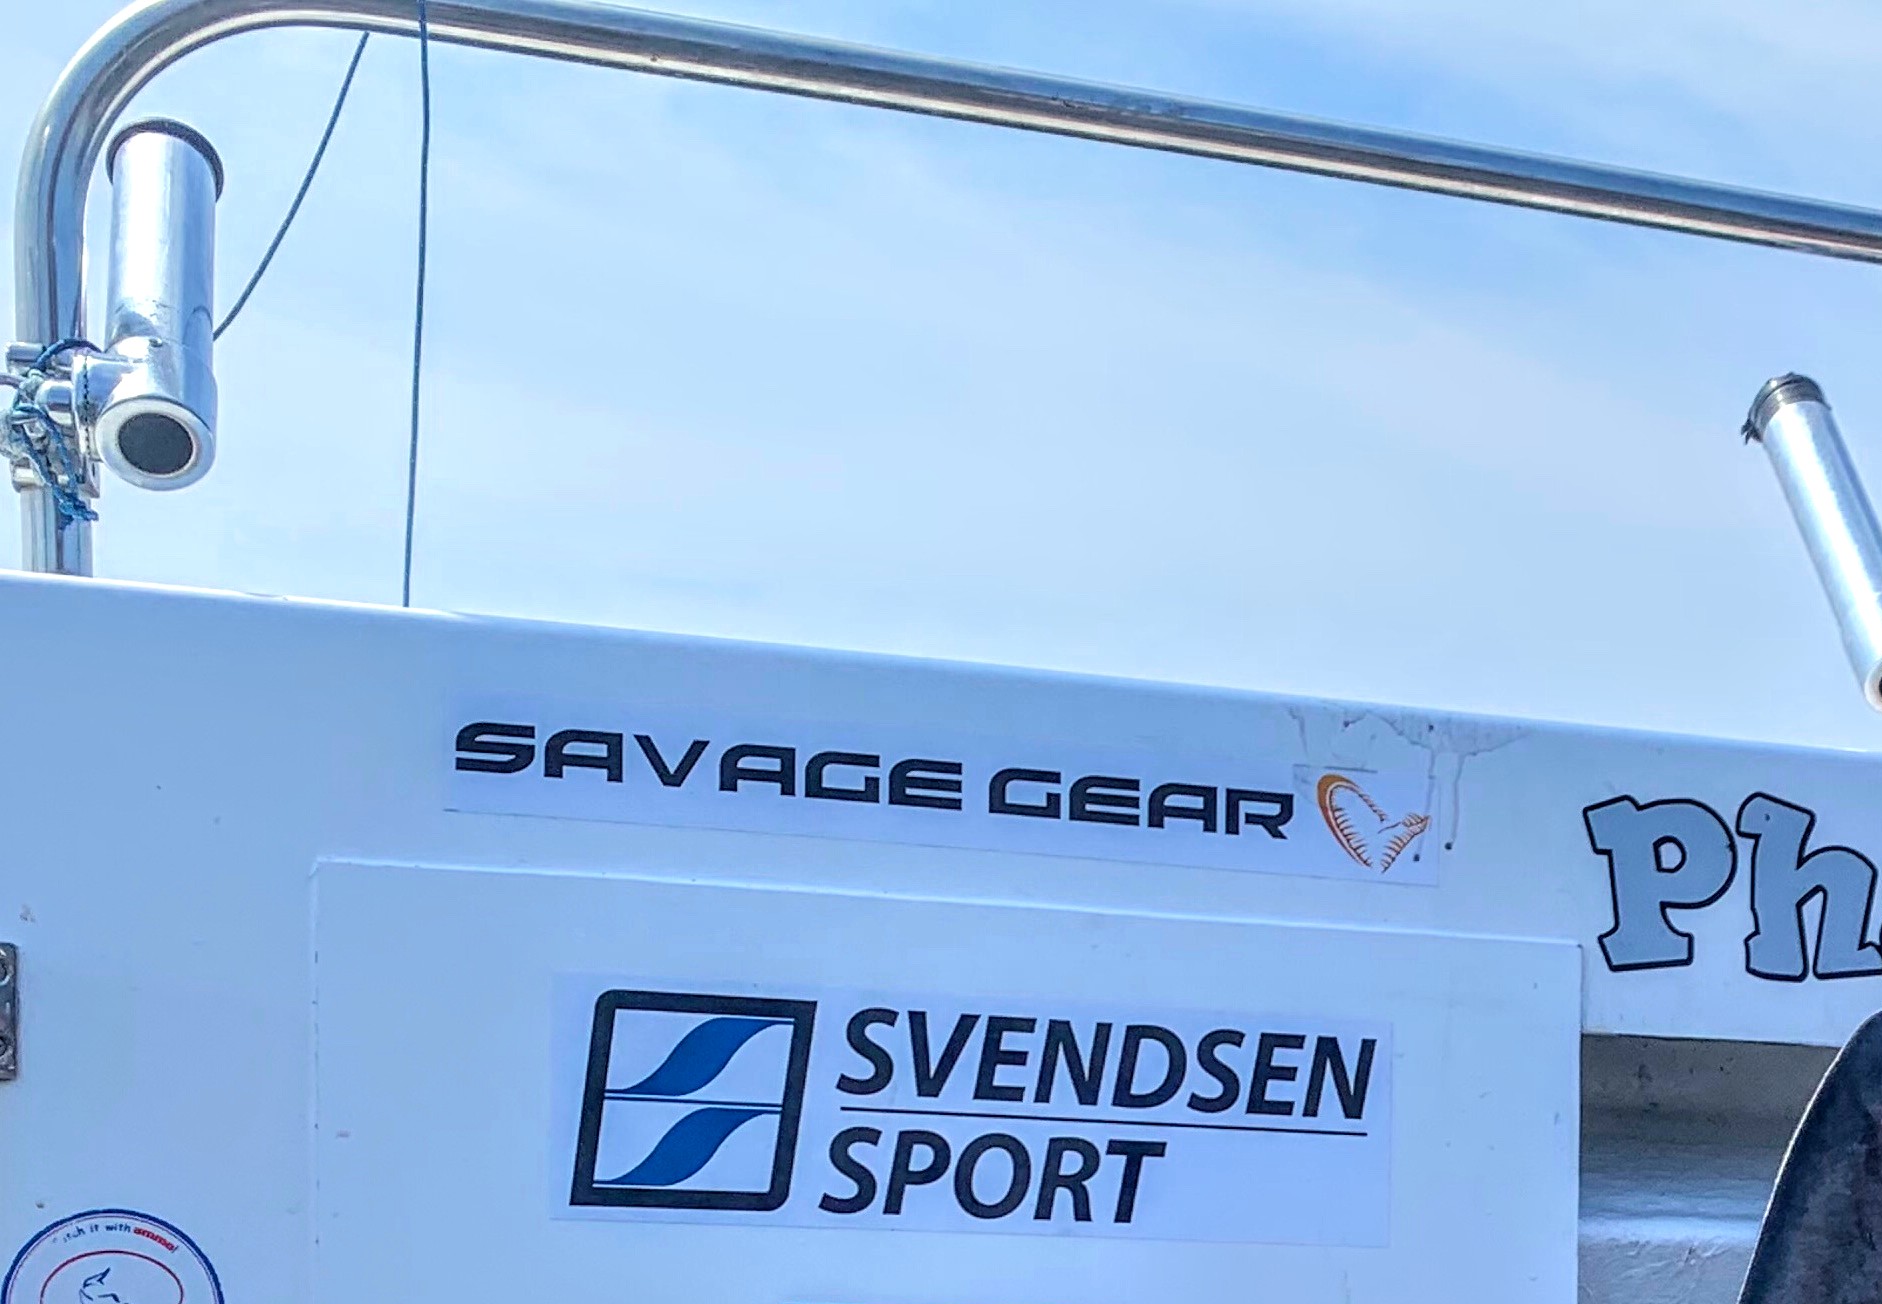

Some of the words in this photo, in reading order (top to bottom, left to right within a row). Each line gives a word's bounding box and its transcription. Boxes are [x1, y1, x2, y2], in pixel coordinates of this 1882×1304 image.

[454, 721, 964, 812] SAVAGE
[988, 767, 1294, 840] GEAR
[836, 1006, 1378, 1120] SVENDSEN
[105, 1223, 131, 1232] with
[818, 1127, 1167, 1224] SPORT
